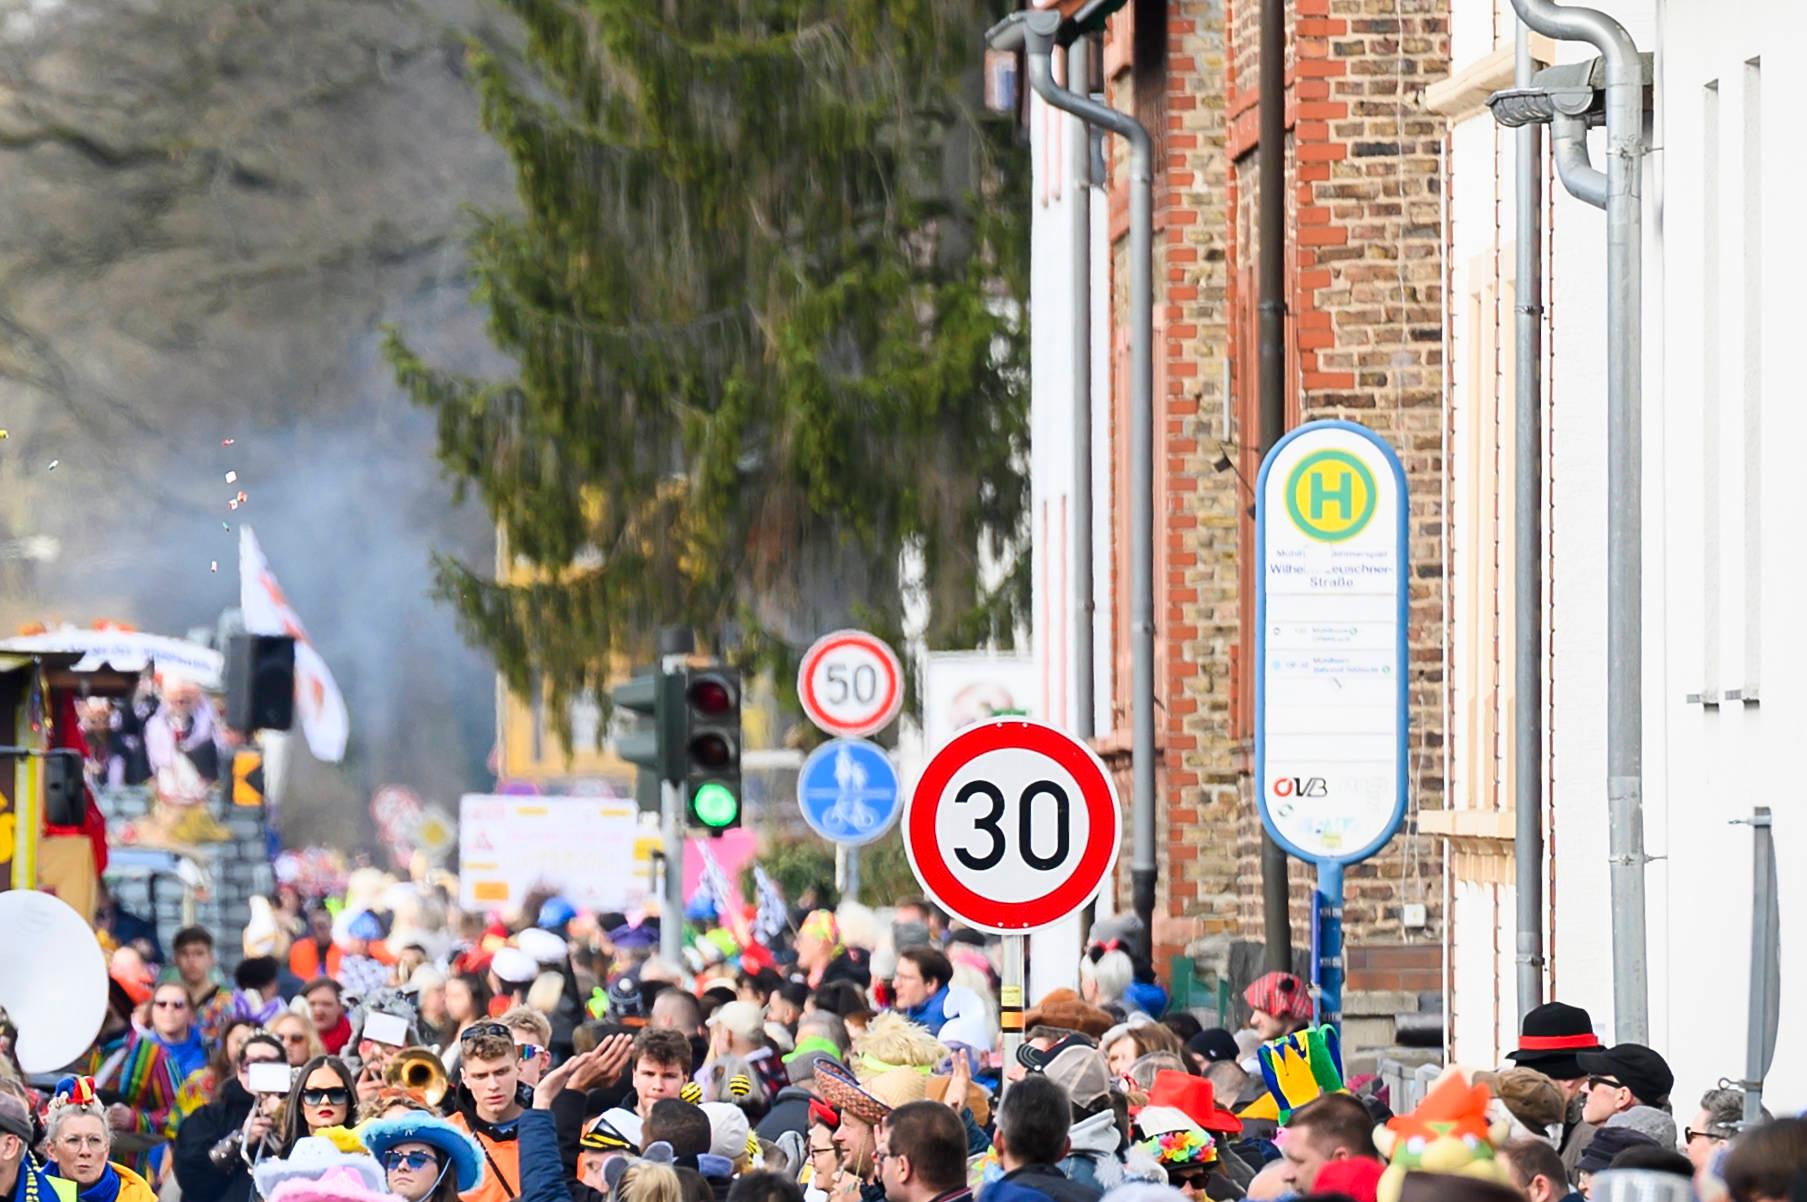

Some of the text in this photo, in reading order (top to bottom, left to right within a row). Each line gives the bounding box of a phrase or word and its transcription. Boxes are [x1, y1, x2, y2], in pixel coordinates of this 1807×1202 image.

[1310, 472, 1351, 519] H
[827, 663, 877, 705] 50
[953, 779, 1070, 871] 30
